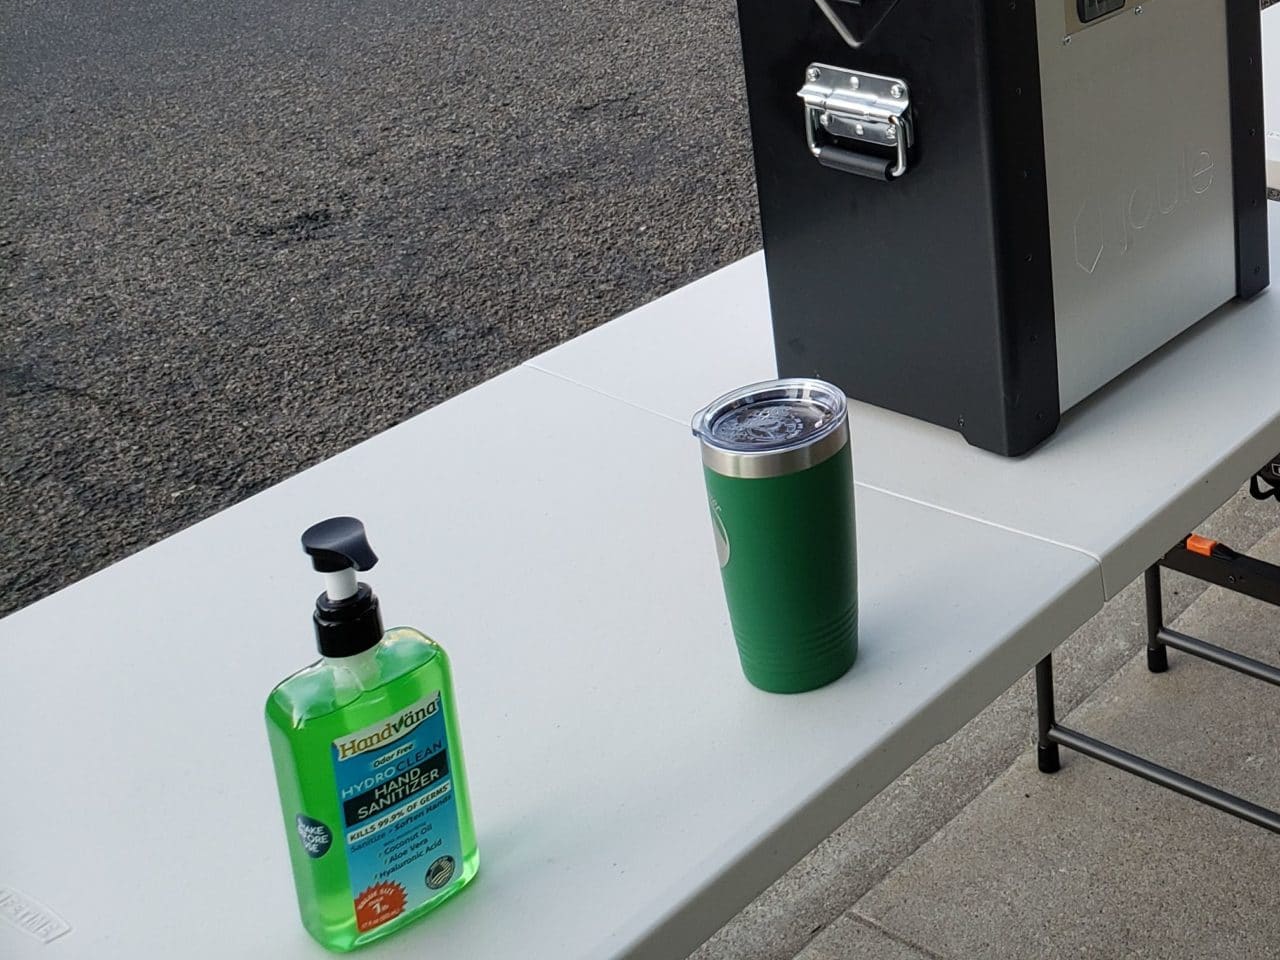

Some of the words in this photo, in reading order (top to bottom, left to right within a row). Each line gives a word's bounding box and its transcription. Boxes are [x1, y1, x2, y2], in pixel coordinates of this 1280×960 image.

[358, 769, 440, 820] SANITIZER
[374, 767, 421, 800] HAND
[350, 825, 377, 841] KILLS
[406, 802, 418, 812] OF
[420, 783, 450, 805] GERMS
[384, 832, 419, 855] Coconut
[388, 849, 408, 864] Aloe
[425, 838, 442, 854] Acid
